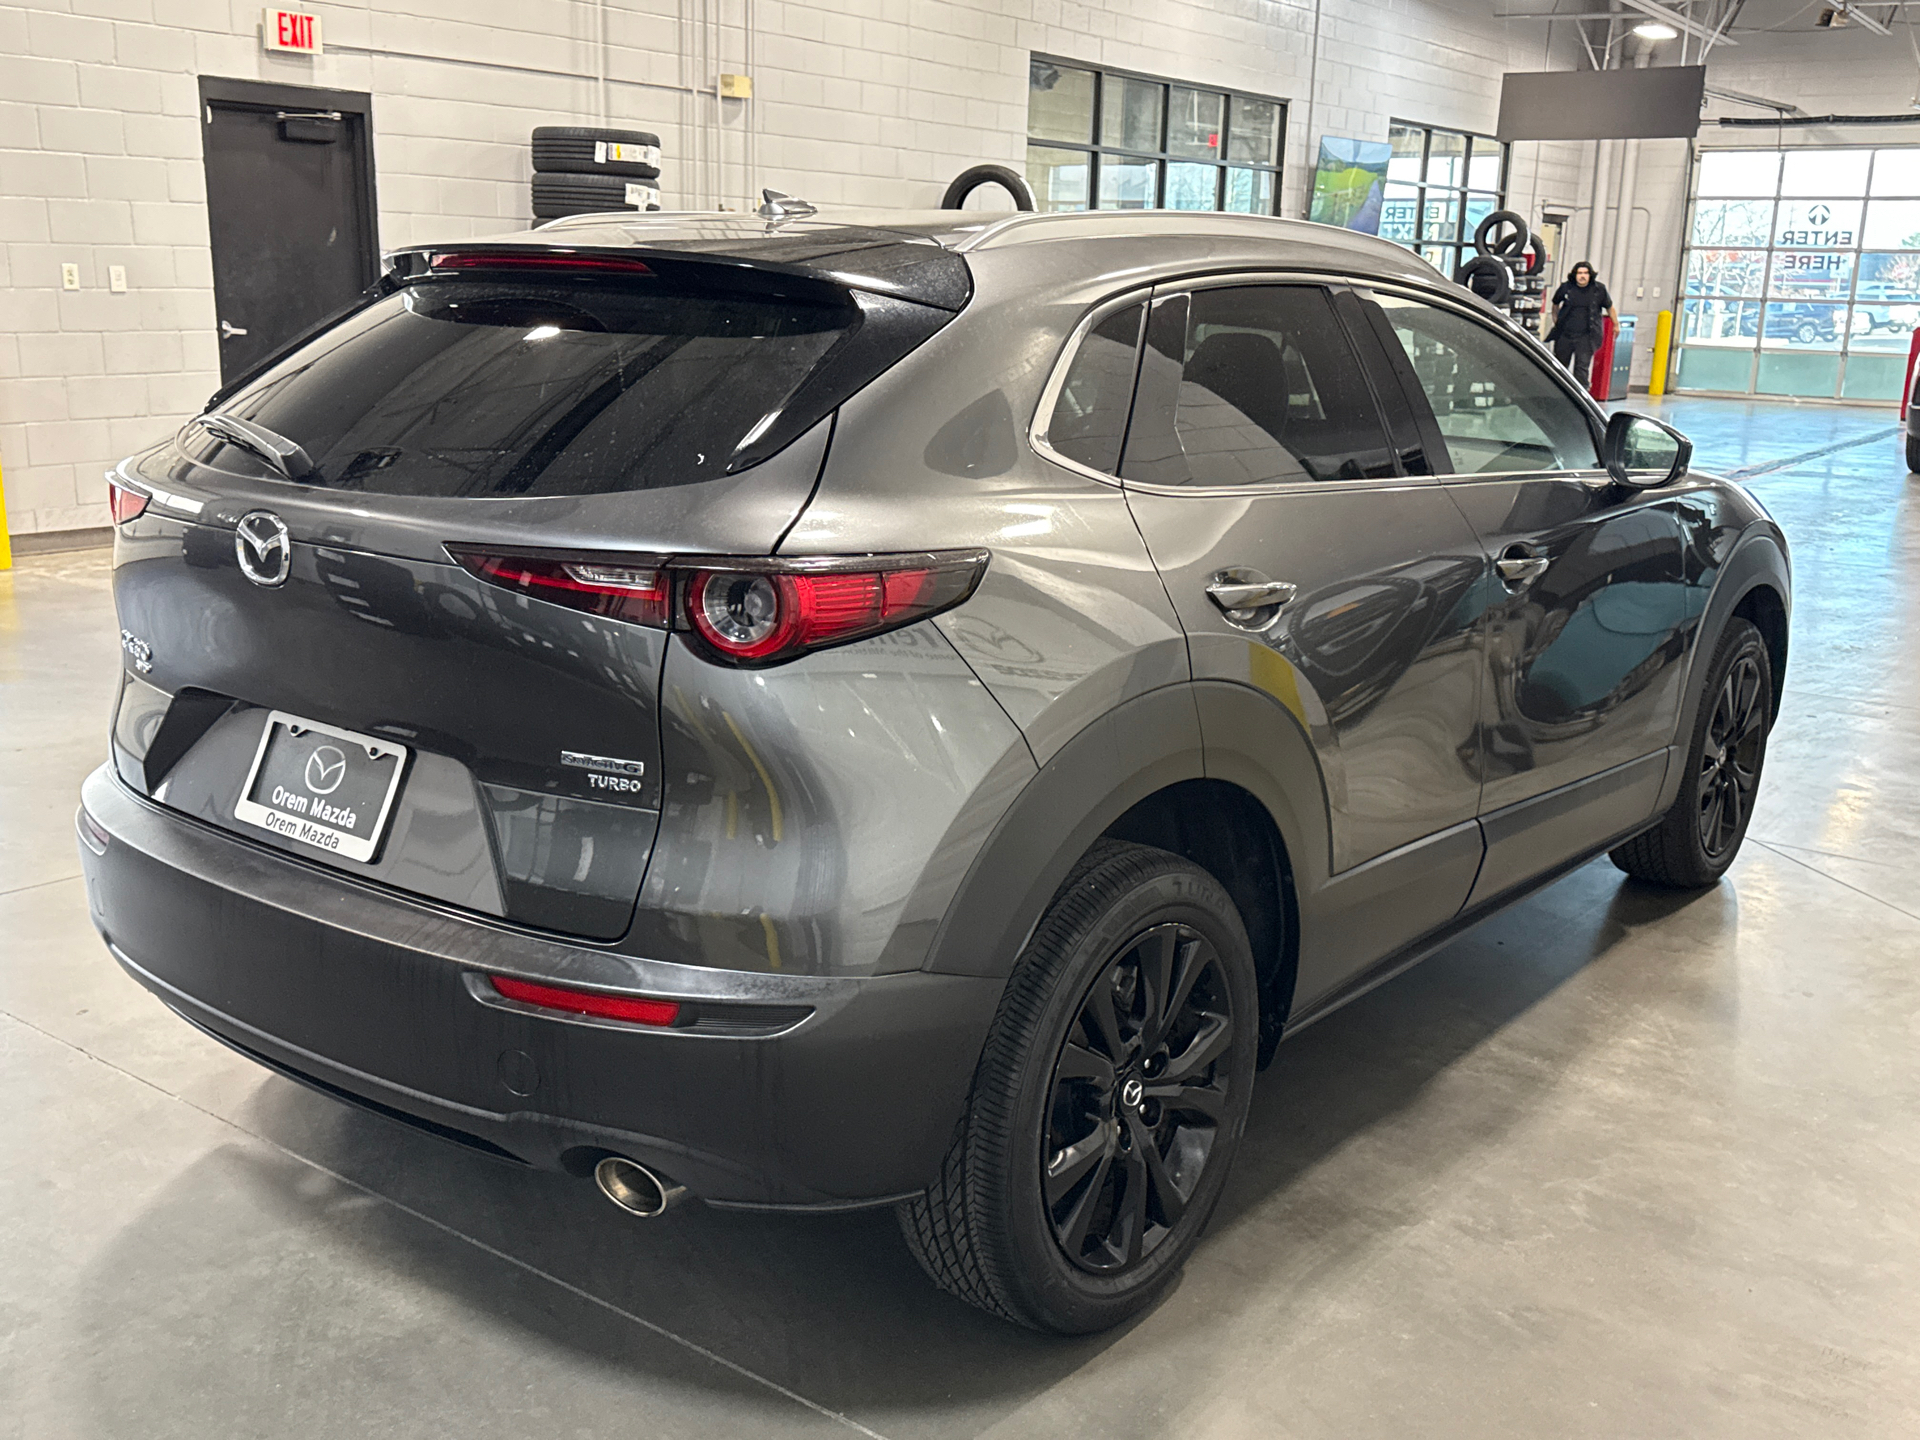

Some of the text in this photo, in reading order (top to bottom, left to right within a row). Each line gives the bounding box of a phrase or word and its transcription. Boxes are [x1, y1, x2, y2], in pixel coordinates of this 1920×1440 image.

[277, 11, 314, 50] EXIT
[587, 773, 642, 793] TURBO
[271, 785, 357, 829] Orem Mazda
[265, 811, 340, 849] Orem Mazda
